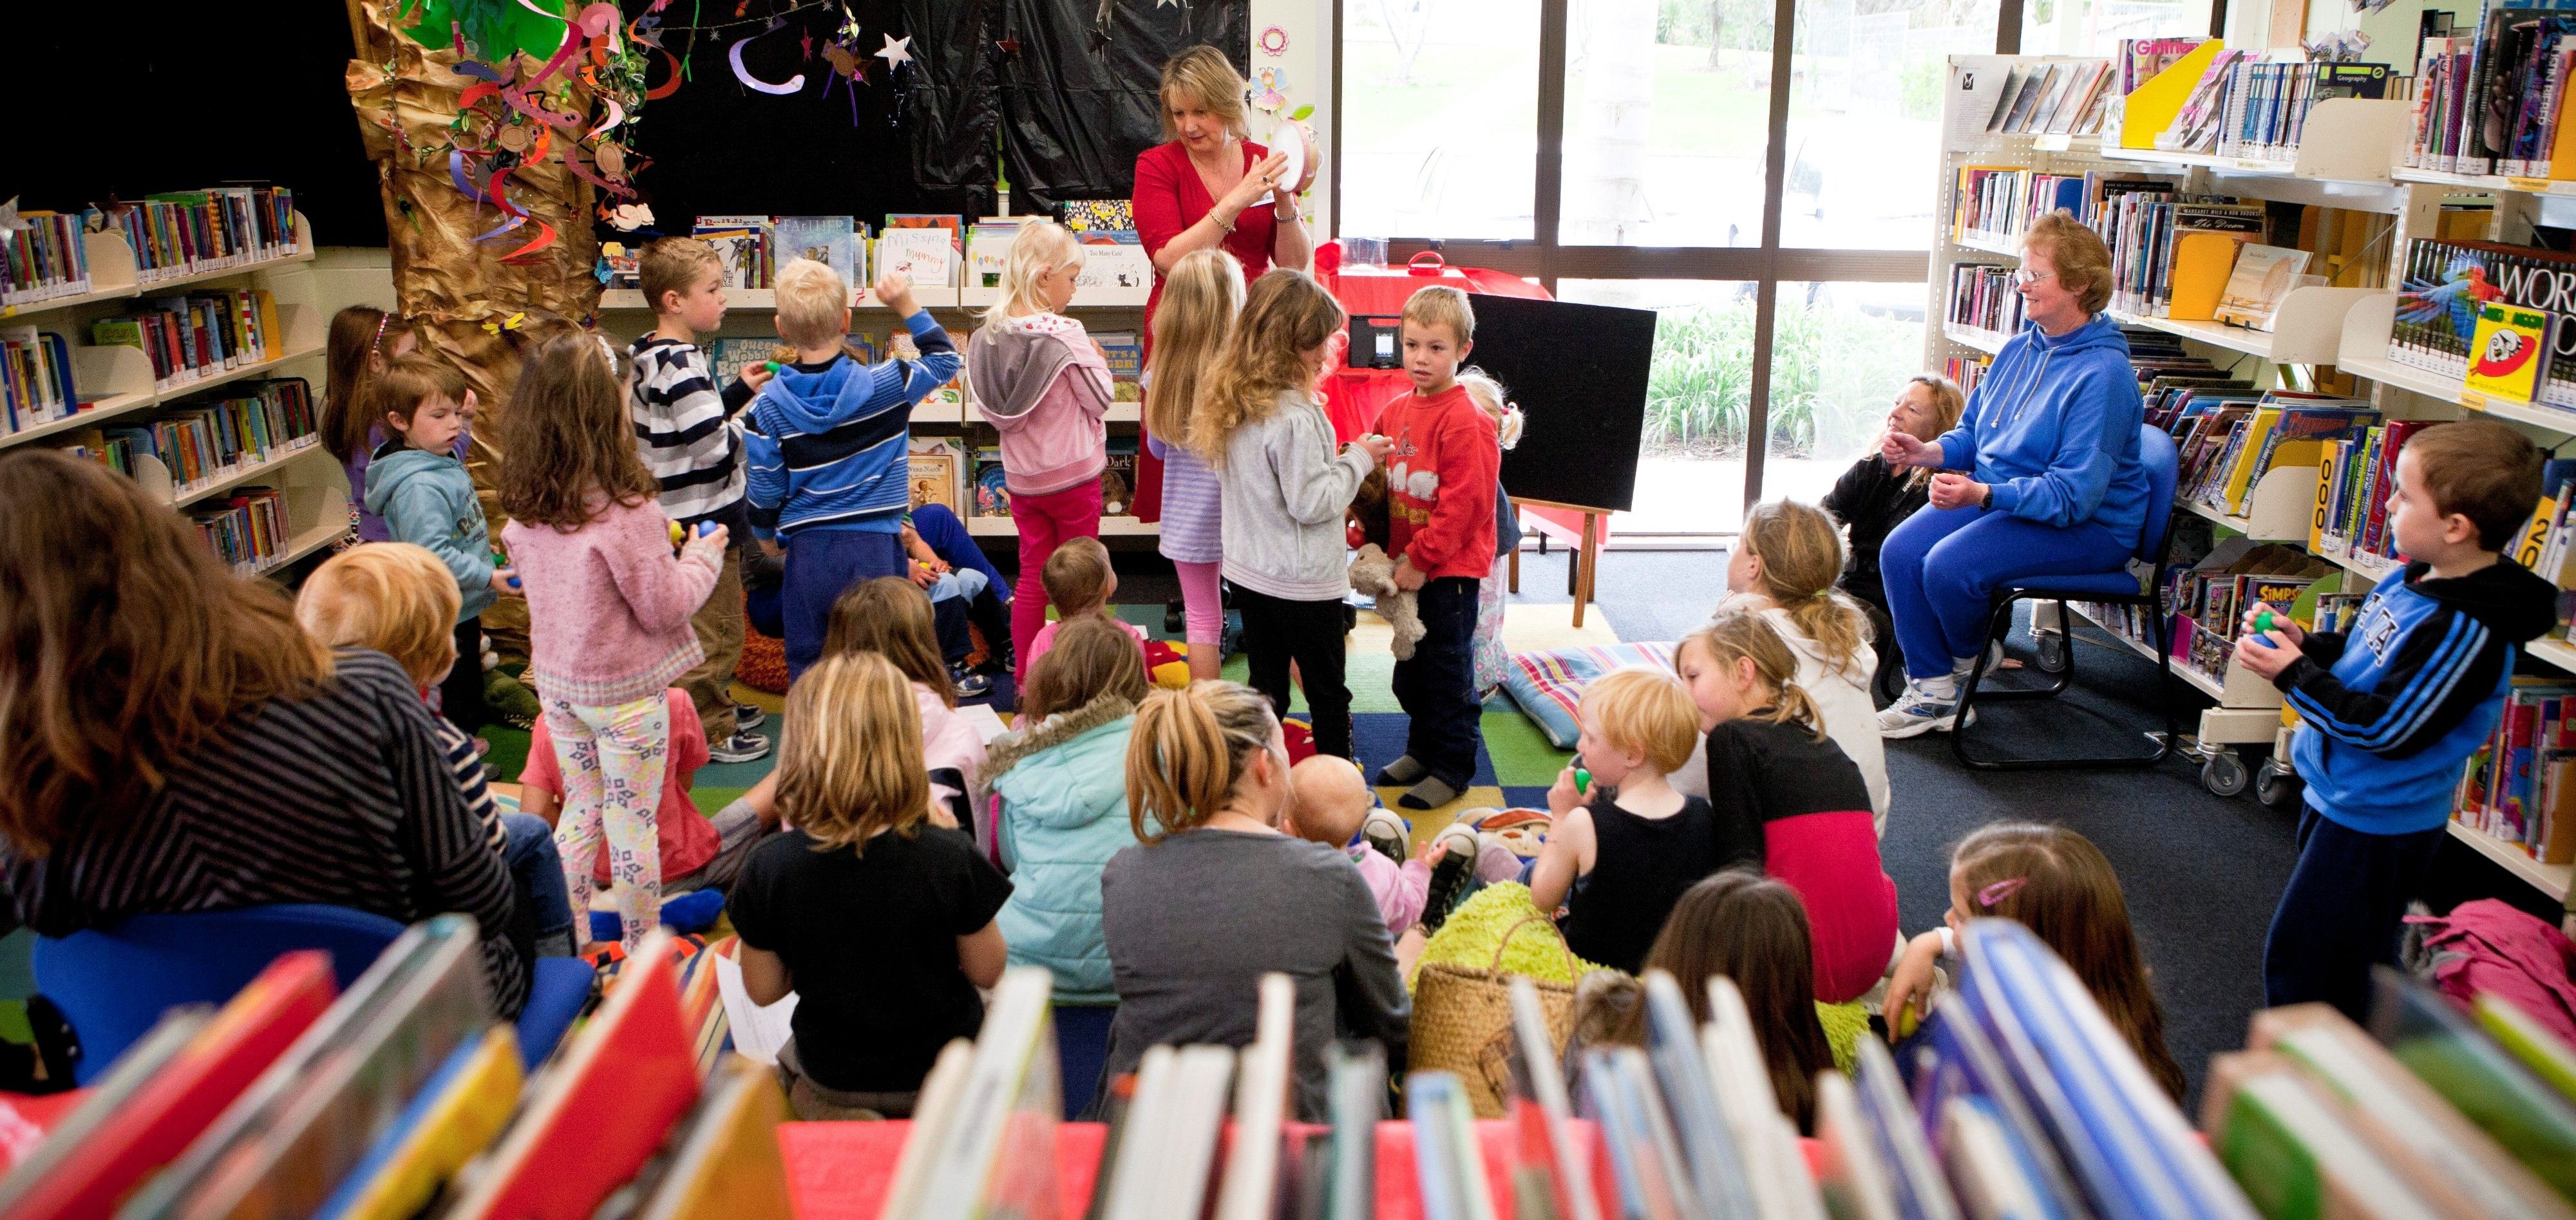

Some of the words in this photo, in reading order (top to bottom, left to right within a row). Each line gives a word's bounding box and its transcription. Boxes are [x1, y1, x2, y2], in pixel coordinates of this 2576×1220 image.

[2136, 40, 2204, 55] Girlfrien
[2193, 219, 2211, 228] The
[2215, 219, 2245, 229] Dream
[887, 233, 949, 253] Missing
[1107, 455, 1132, 467] Dark
[2260, 585, 2302, 603] SiMPS
